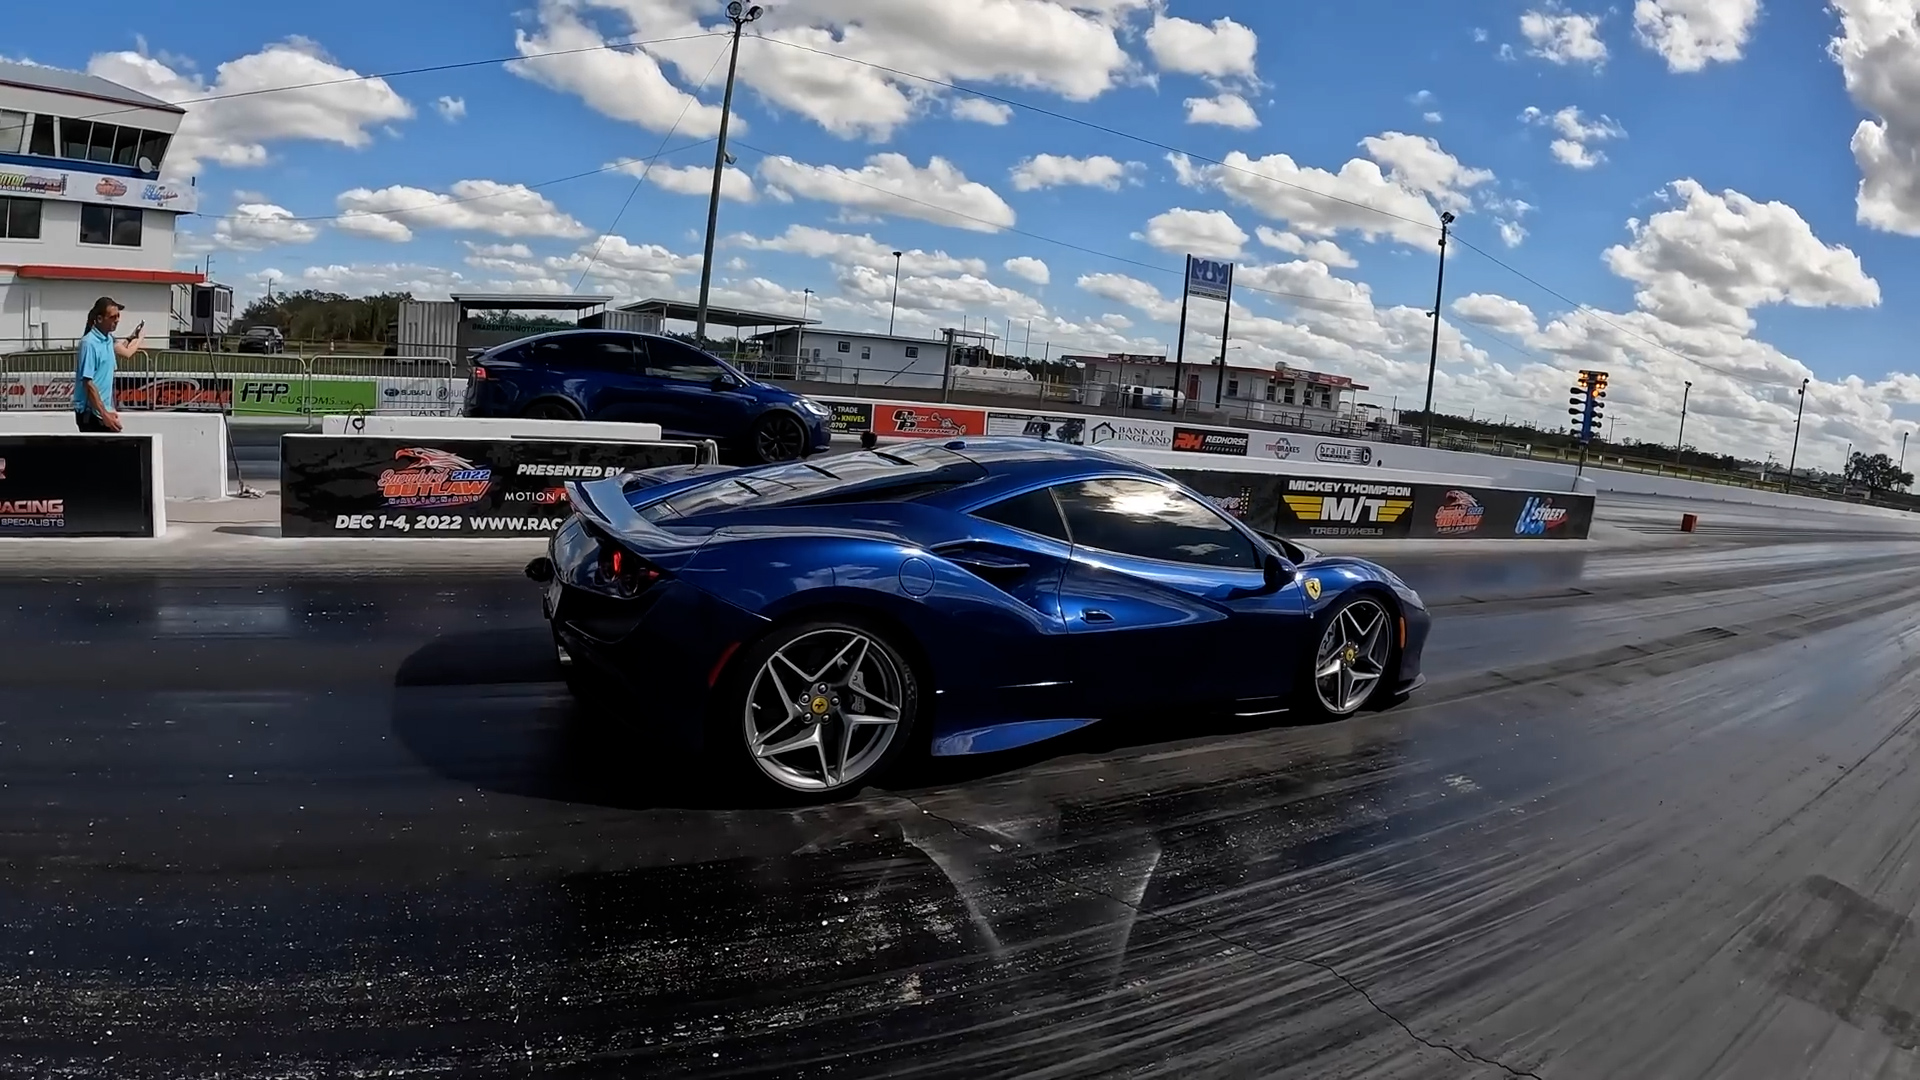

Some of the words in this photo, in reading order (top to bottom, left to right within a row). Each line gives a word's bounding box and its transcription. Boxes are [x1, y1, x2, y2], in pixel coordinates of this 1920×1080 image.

[837, 406, 859, 414] TRADE
[841, 414, 866, 423] KNIVES
[1119, 426, 1149, 436] BANK
[1152, 429, 1166, 437] OF
[1118, 433, 1171, 444] ENGLAND
[1205, 435, 1249, 446] REDHORSE
[1202, 445, 1245, 454] PERFORMANCE
[1320, 445, 1352, 456] braille
[516, 464, 602, 477] PRESENTED
[604, 466, 626, 477] BY
[378, 468, 450, 487] Snowbird
[450, 469, 491, 481] 2022
[382, 480, 490, 497] OUTLAW
[1288, 480, 1342, 493] MICKEY
[1342, 483, 1412, 497] THOMPSON
[388, 495, 480, 505] NATIONALS
[504, 491, 556, 501] MOTION
[0, 499, 64, 514] ACING
[1320, 496, 1386, 524] M/T
[1531, 506, 1567, 521] STREET
[1, 517, 65, 528] SPECIALISTS
[334, 515, 375, 530] DEC
[378, 514, 410, 532] 1-4,
[414, 514, 463, 530] 2022
[469, 516, 561, 531] WWW.RAC
[1436, 515, 1482, 527] OUTLAW
[1309, 527, 1339, 535] TIRES
[1347, 528, 1384, 536] WHEELS
